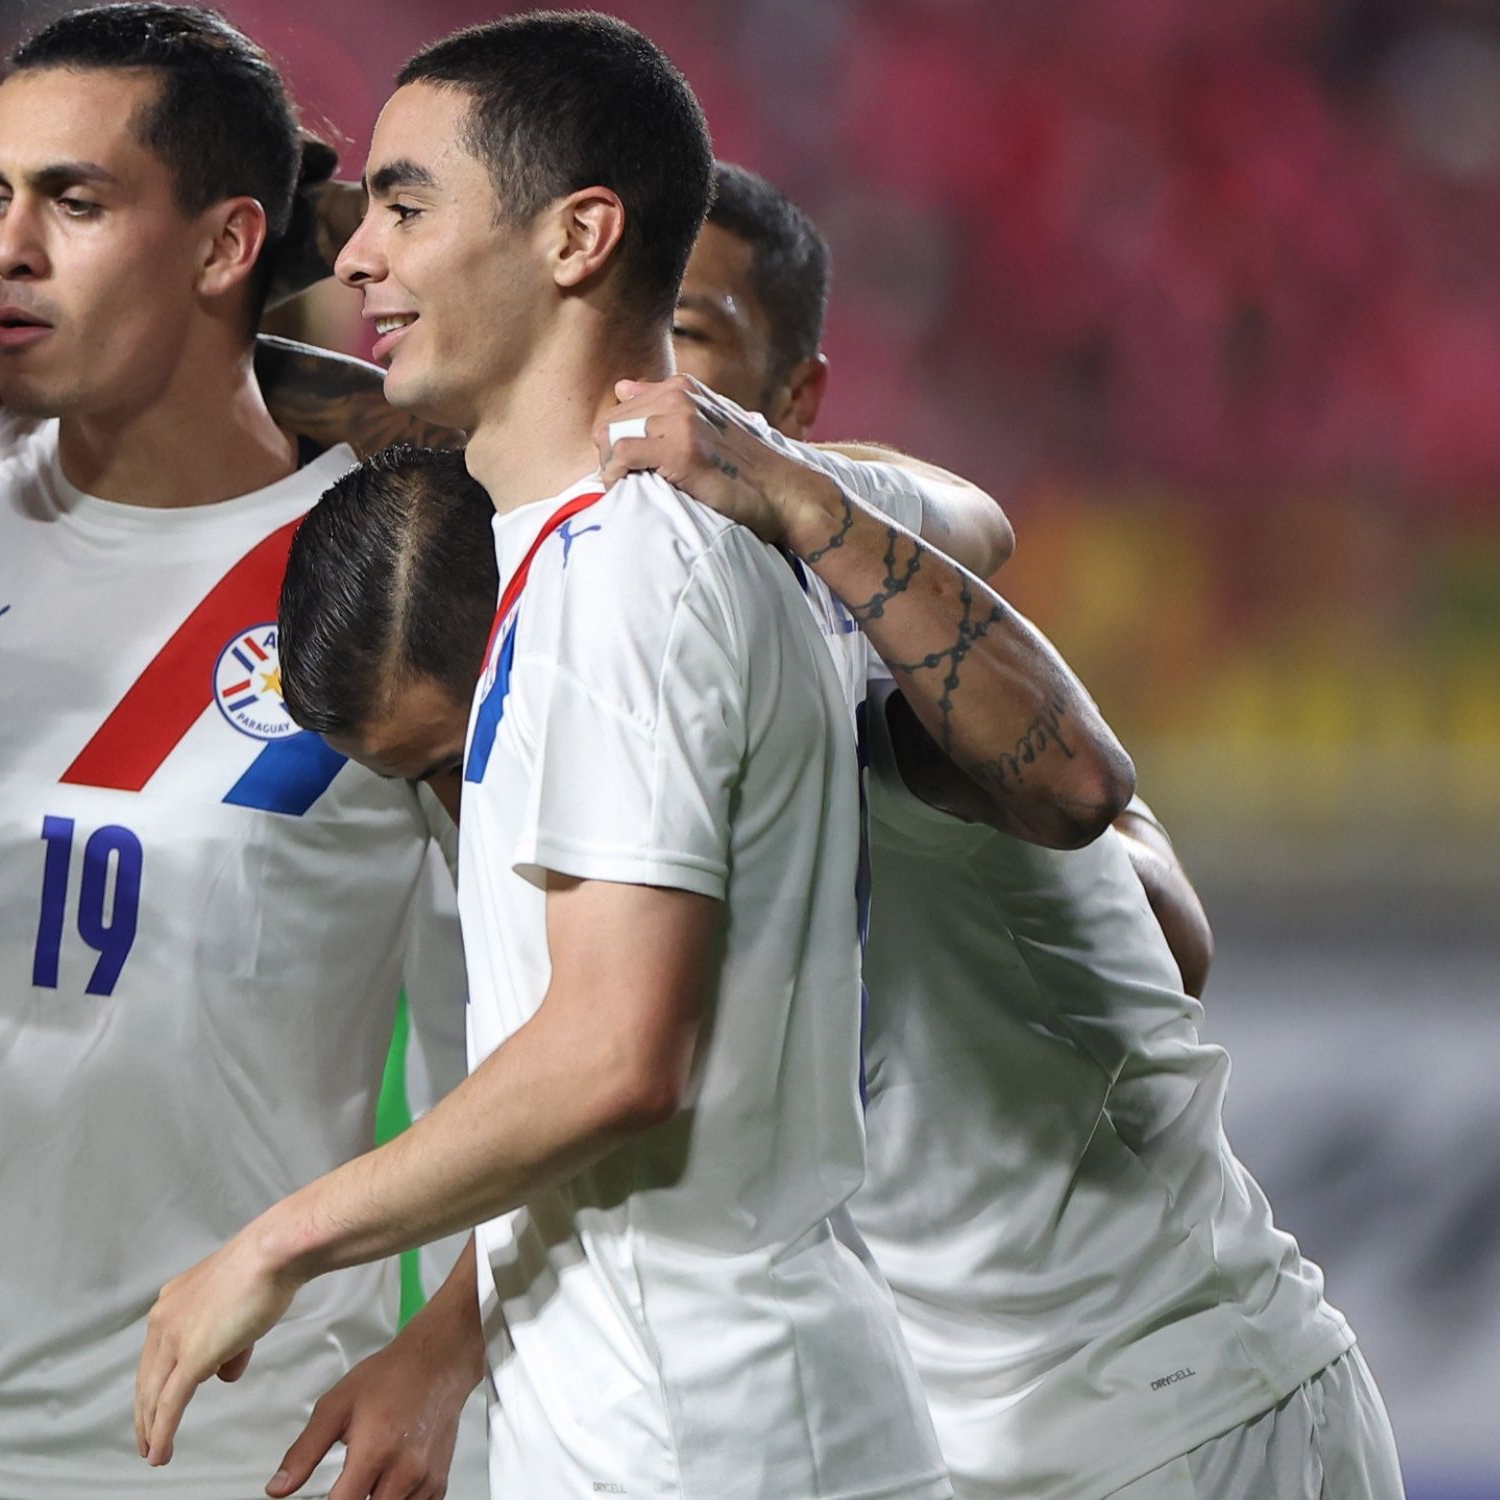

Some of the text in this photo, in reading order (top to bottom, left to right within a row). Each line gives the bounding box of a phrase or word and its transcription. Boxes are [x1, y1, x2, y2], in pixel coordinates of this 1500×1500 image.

[236, 712, 290, 734] PARAGUAY
[32, 814, 143, 997] 19
[1150, 1367, 1196, 1391] DRYCELL
[593, 1482, 627, 1494] DRYCELL
